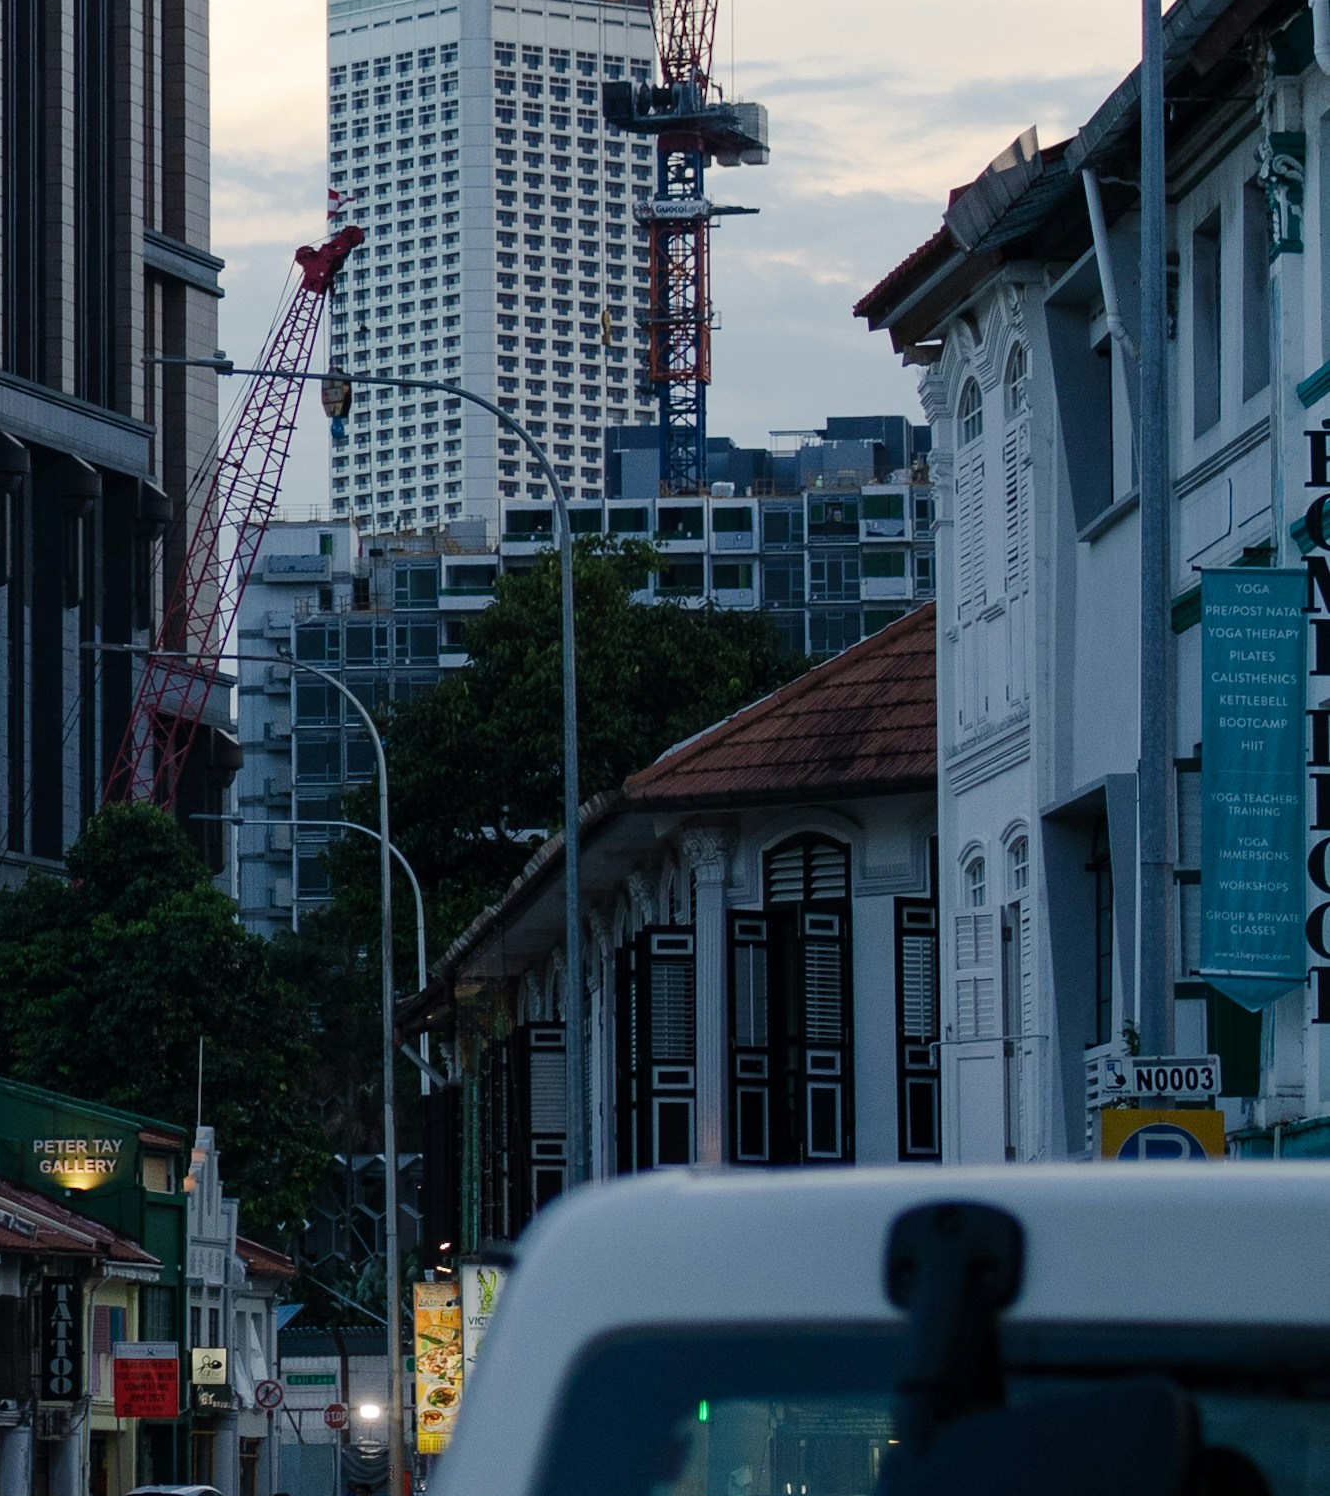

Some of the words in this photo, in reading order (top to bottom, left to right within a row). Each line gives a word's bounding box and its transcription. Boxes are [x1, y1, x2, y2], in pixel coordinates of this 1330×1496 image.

[656, 204, 705, 214] GuocoLand
[1236, 584, 1270, 595] YOGA
[1206, 606, 1263, 617] PRE/POST
[1208, 628, 1243, 639] YOGA
[1247, 629, 1300, 640] THERAPY
[1230, 651, 1276, 662] PILATES
[1211, 672, 1297, 685] CALISTHENICS
[1220, 695, 1289, 707] KETTLEBELL
[1220, 717, 1289, 729] BOOTCAMP
[1242, 741, 1265, 751] HIIT
[1211, 793, 1241, 803] YOGA
[1243, 794, 1299, 805] TEACHERS
[1229, 806, 1281, 817] TRAINING
[1238, 837, 1269, 847] YOGA
[1219, 850, 1290, 862] IMMERSIONS
[1220, 881, 1289, 893] WORKSHOPS
[1206, 911, 1245, 922] GROUP
[1247, 911, 1256, 922] &
[1258, 913, 1301, 924] PRIVATE
[1230, 924, 1277, 936] CLASSES
[1136, 1068, 1215, 1092] N0003
[33, 1139, 88, 1154] PETER
[92, 1139, 123, 1154] TAY
[40, 1159, 117, 1174] GALLERY
[50, 1284, 72, 1395] TATTOO
[325, 1411, 347, 1422] STOP
